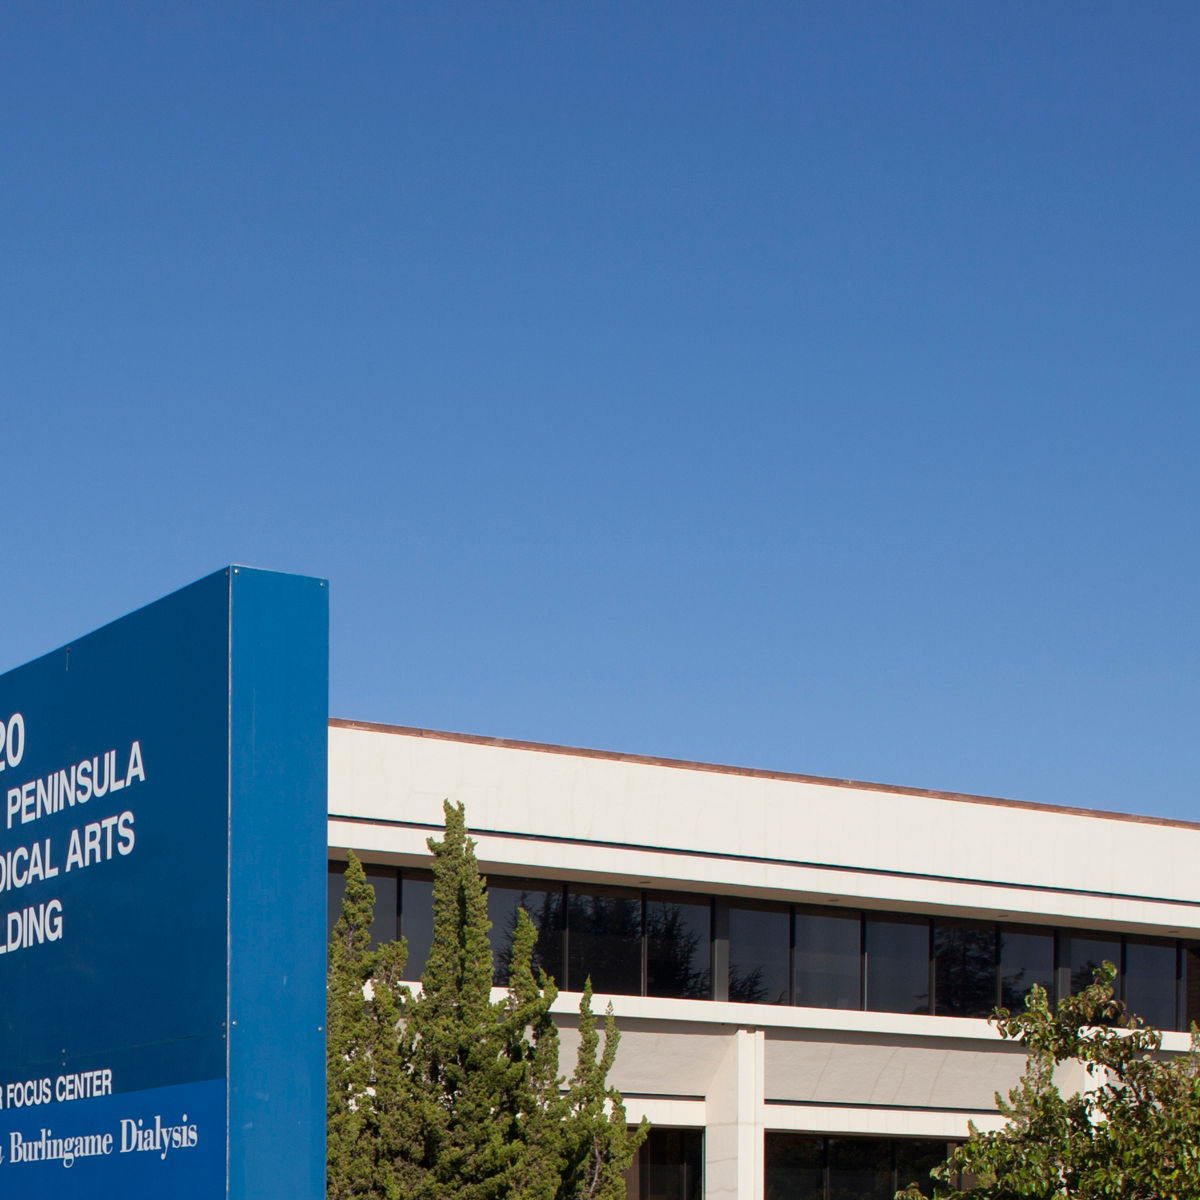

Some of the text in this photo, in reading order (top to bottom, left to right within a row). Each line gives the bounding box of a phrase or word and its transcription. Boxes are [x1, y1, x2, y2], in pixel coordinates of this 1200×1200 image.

[6, 740, 146, 830] PENINSULA
[65, 810, 136, 873] ARTS
[6, 1077, 52, 1109] FOCUS
[55, 1068, 113, 1102] CENTER
[8, 1128, 114, 1169] Burlingame
[119, 1113, 199, 1160] Dialysis
